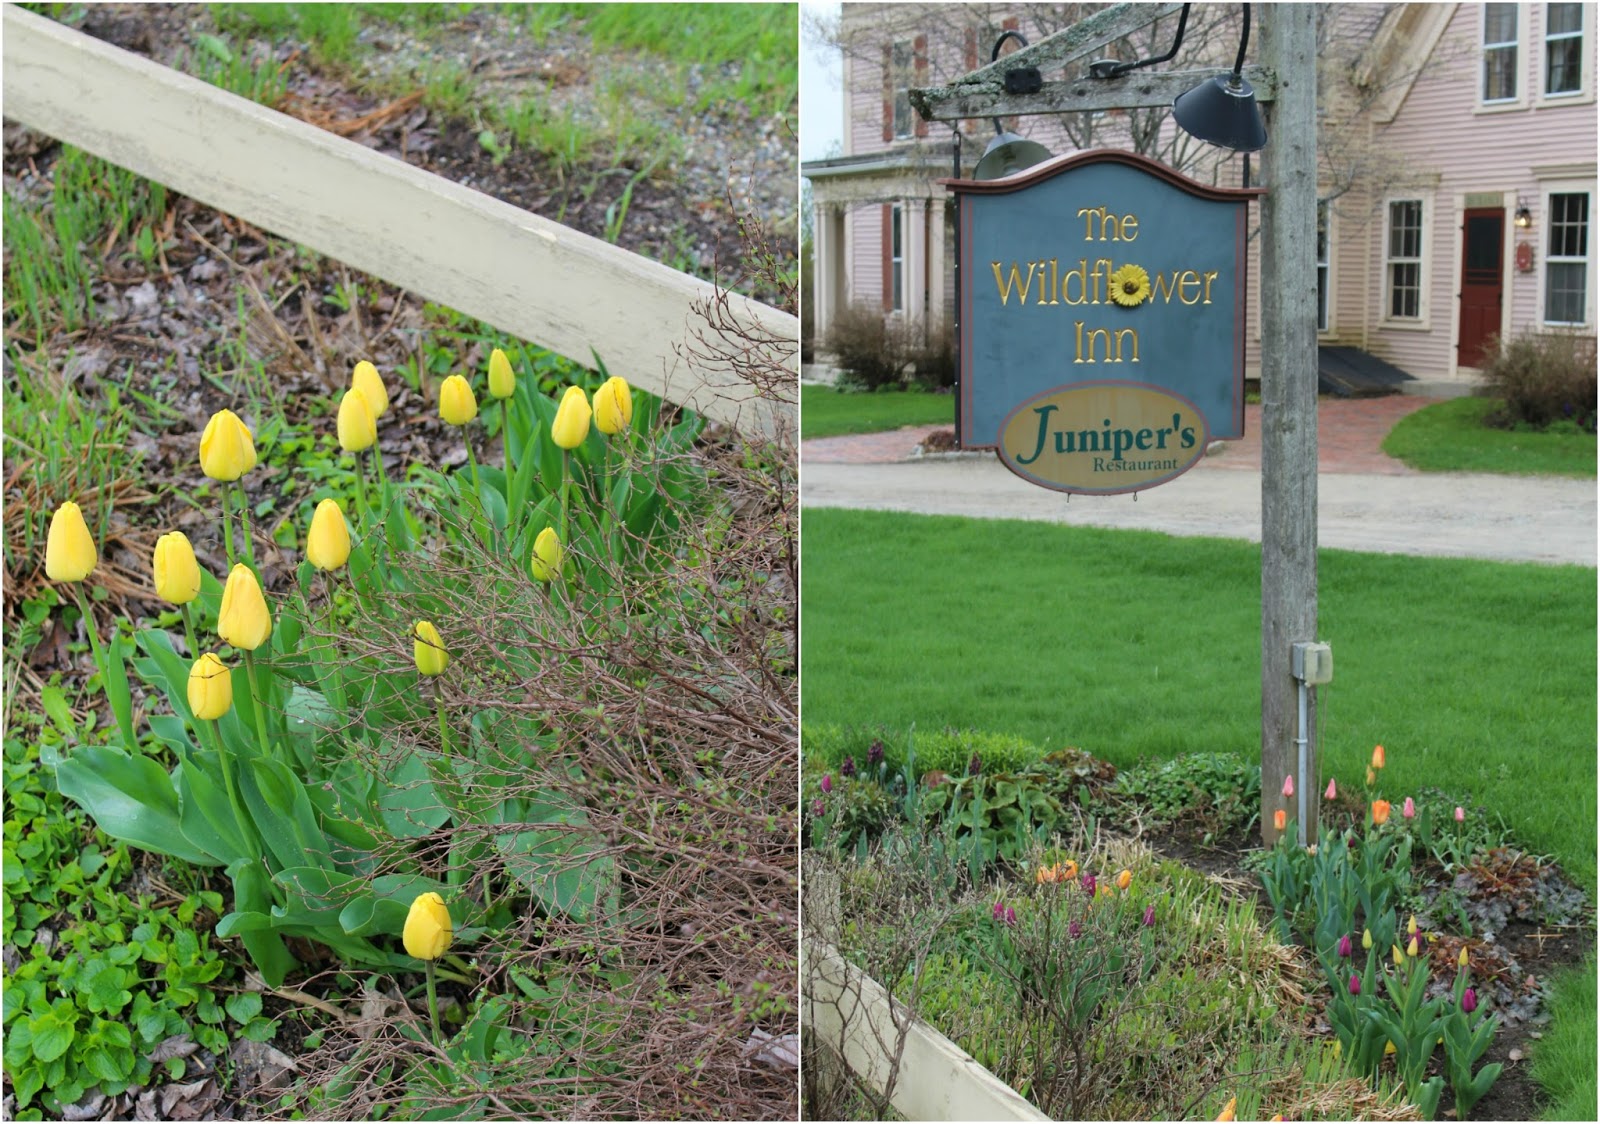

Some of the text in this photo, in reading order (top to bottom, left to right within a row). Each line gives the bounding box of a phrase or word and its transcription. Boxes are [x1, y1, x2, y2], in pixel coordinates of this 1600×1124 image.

[1077, 206, 1139, 242] The
[991, 257, 1219, 307] Wildflower
[1073, 321, 1140, 364] Inn
[1016, 405, 1196, 465] Juniper's
[1093, 456, 1178, 473] Restaurant
